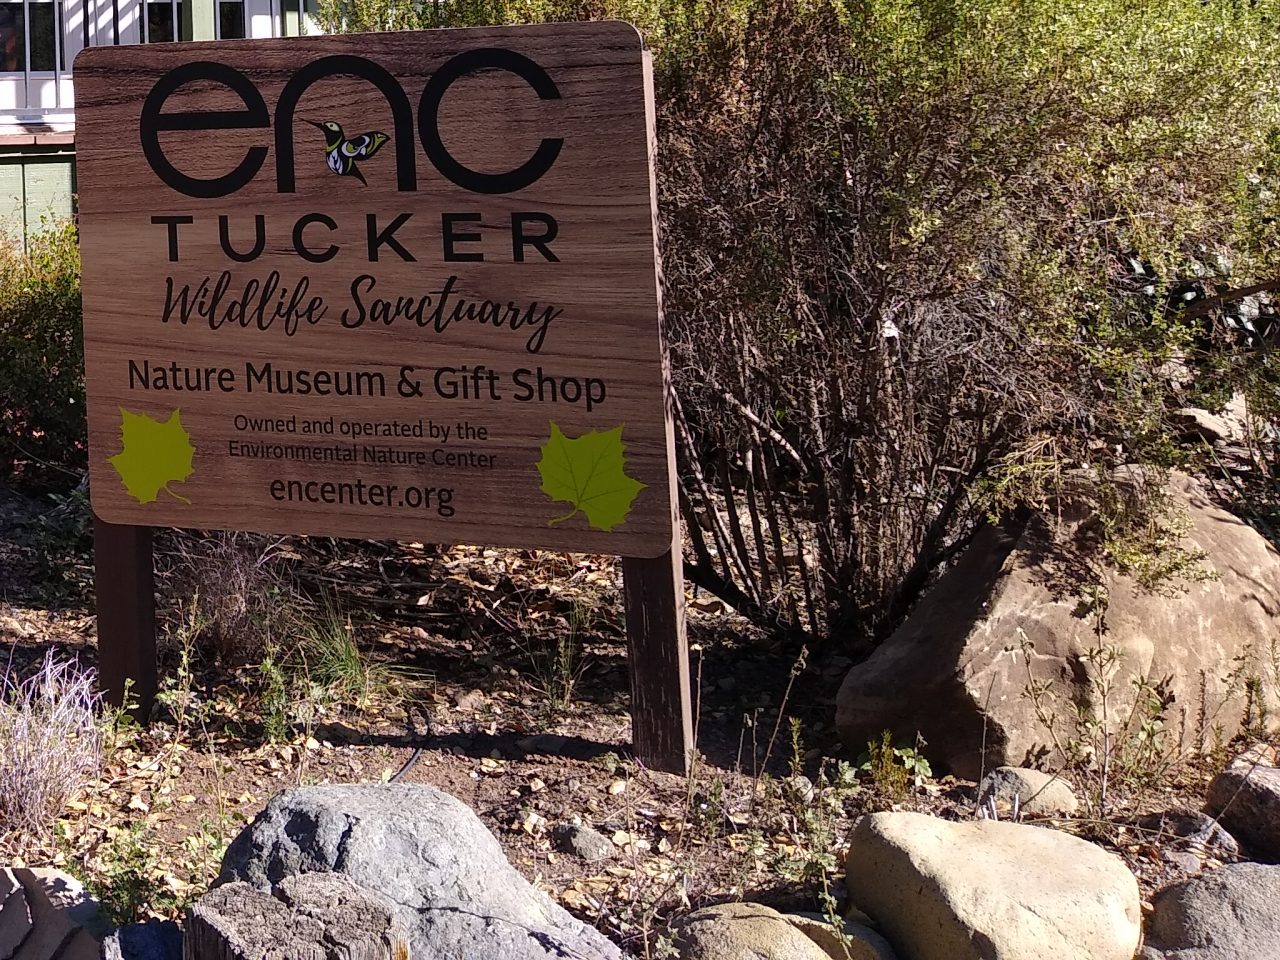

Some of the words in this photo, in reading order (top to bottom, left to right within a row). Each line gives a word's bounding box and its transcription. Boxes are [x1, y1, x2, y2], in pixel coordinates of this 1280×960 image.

[150, 212, 561, 263] TUCKER
[161, 270, 328, 336] Wildlife
[340, 273, 563, 353] Sanctuary
[128, 359, 235, 392] Nature
[246, 361, 386, 398] Museum
[396, 365, 424, 399] &
[433, 365, 502, 401] Gift
[512, 367, 607, 413] Shop
[233, 414, 296, 433] Owned
[302, 417, 334, 434] and
[339, 419, 423, 440] operated
[429, 420, 451, 443] by
[456, 422, 488, 441] the
[228, 440, 357, 462] Environmental
[363, 445, 426, 465] Nature
[431, 448, 497, 468] Center
[269, 477, 456, 518] encenter.org
